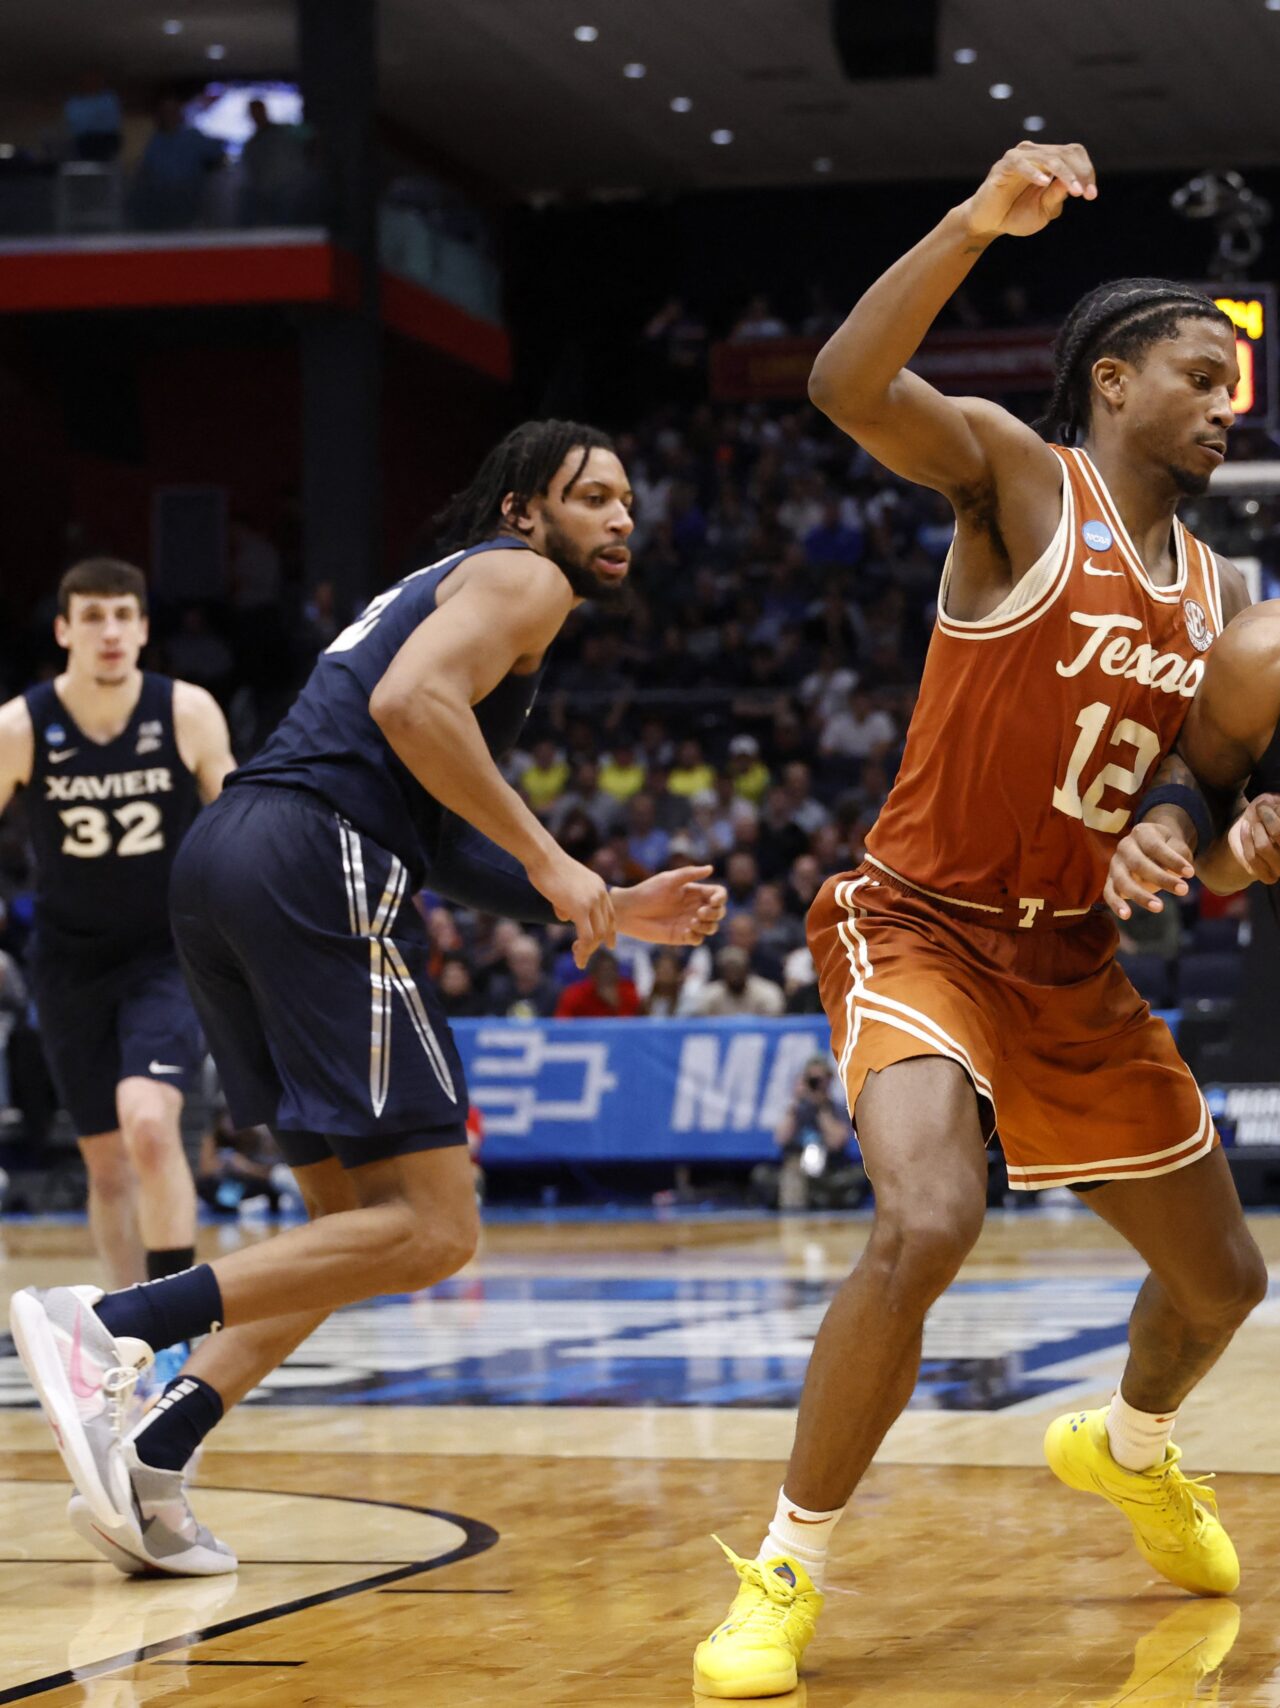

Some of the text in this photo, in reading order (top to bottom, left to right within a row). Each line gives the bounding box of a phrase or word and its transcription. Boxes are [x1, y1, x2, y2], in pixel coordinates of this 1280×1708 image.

[44, 766, 173, 801] XAVIER
[1052, 701, 1160, 833] 12
[58, 801, 164, 858] 32
[1018, 898, 1045, 928] T
